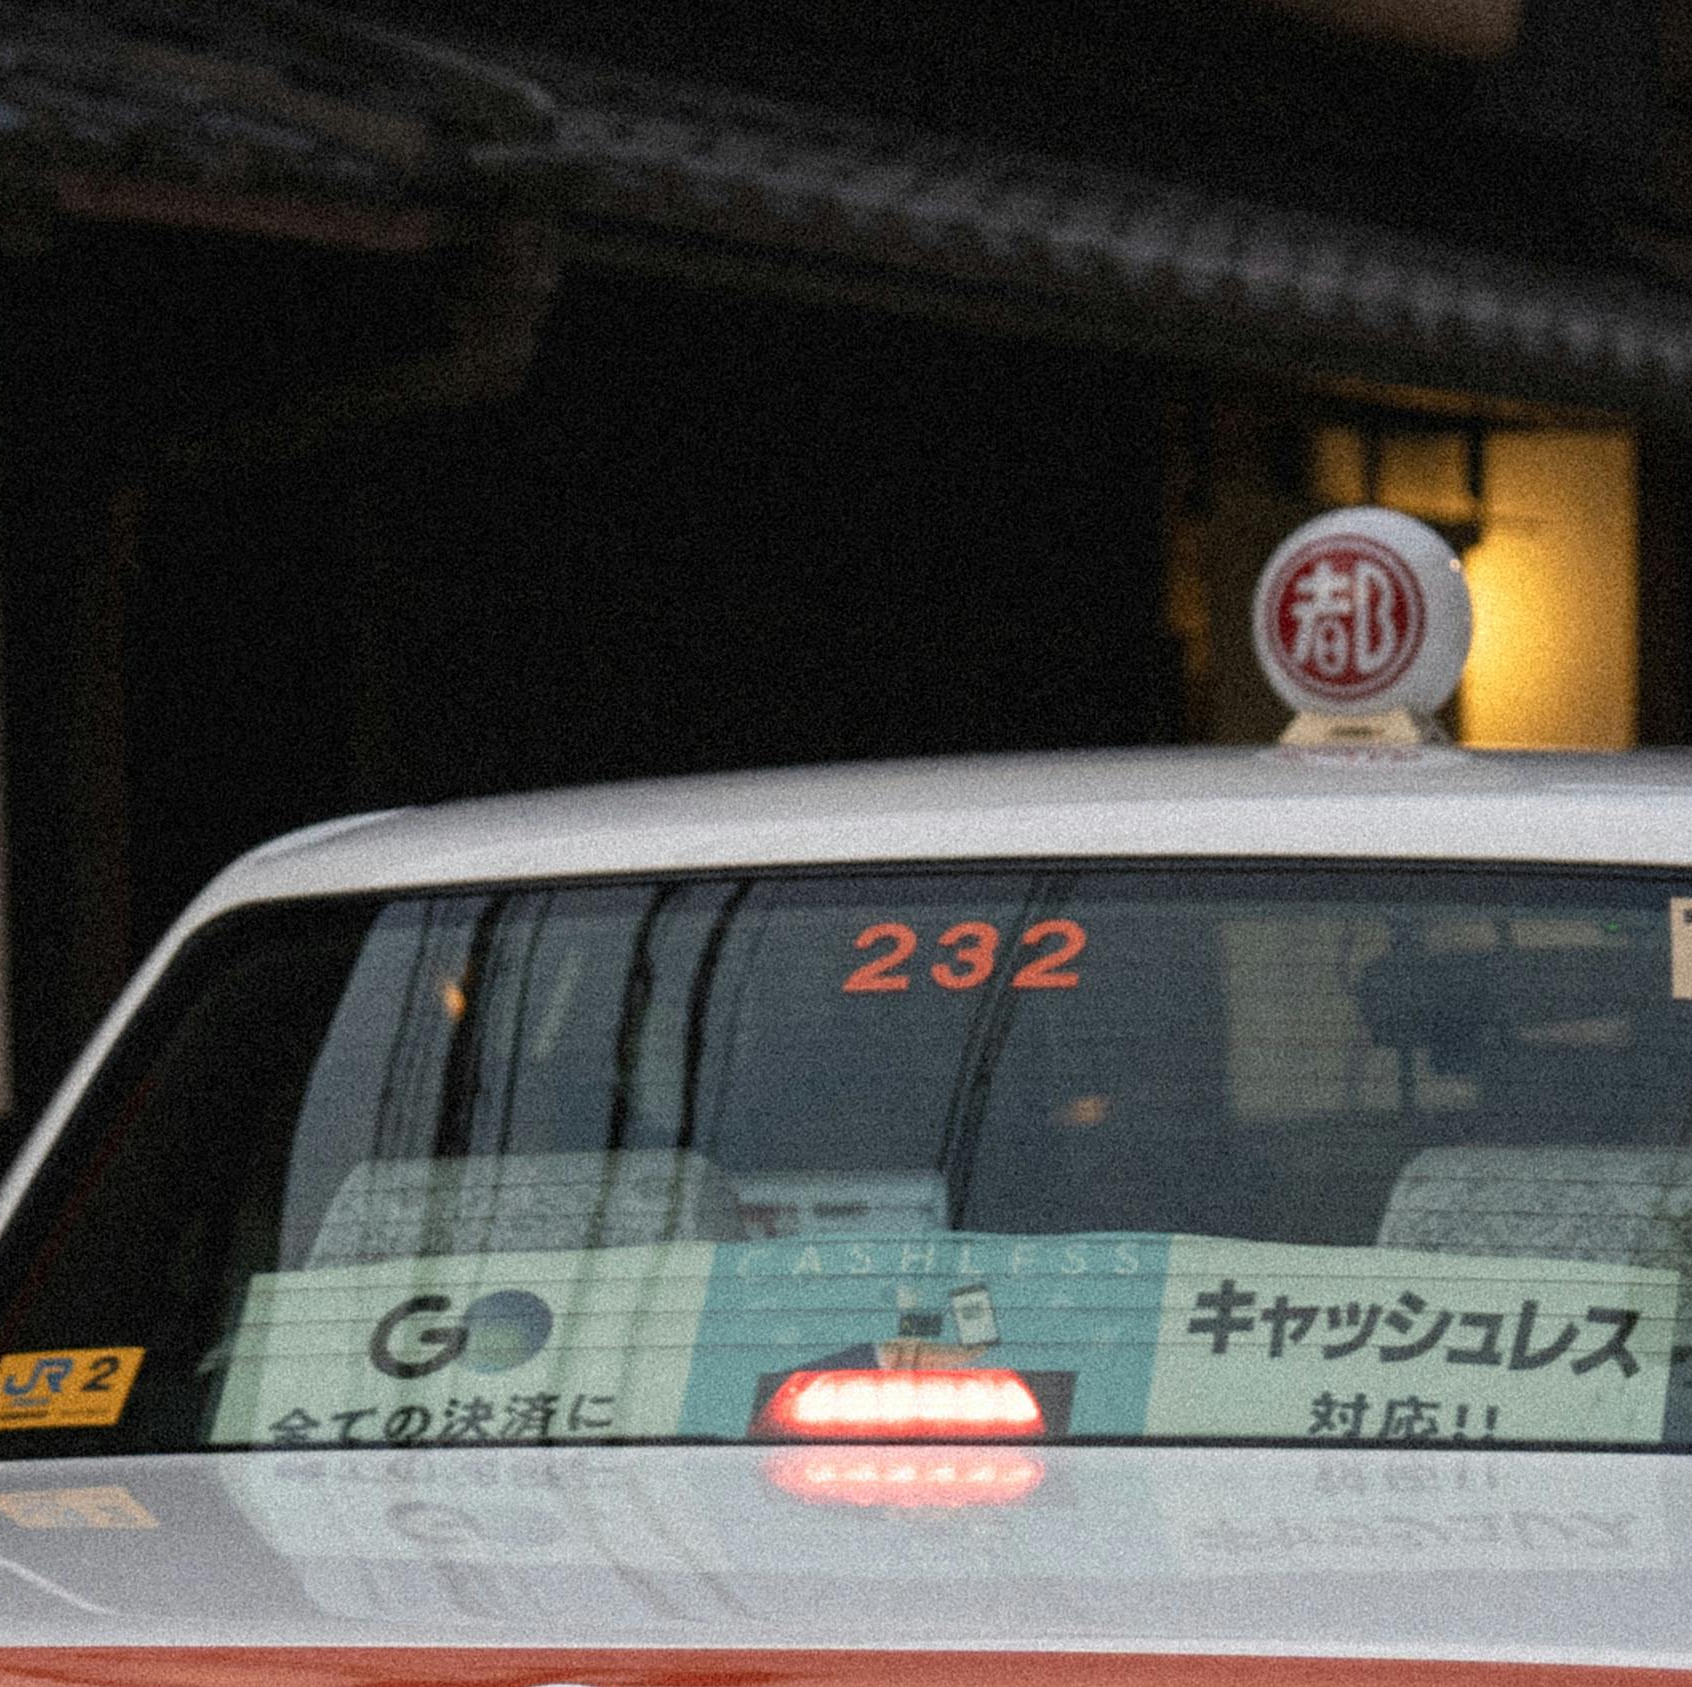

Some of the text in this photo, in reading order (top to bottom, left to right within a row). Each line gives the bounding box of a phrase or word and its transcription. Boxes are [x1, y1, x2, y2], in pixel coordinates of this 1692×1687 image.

[1293, 560, 1397, 676] 都
[842, 918, 1087, 992] 232
[1188, 1278, 1641, 1378] キャッシュレス
[4, 1355, 120, 1396] JR 2
[269, 1394, 616, 1442] 全ての決済に
